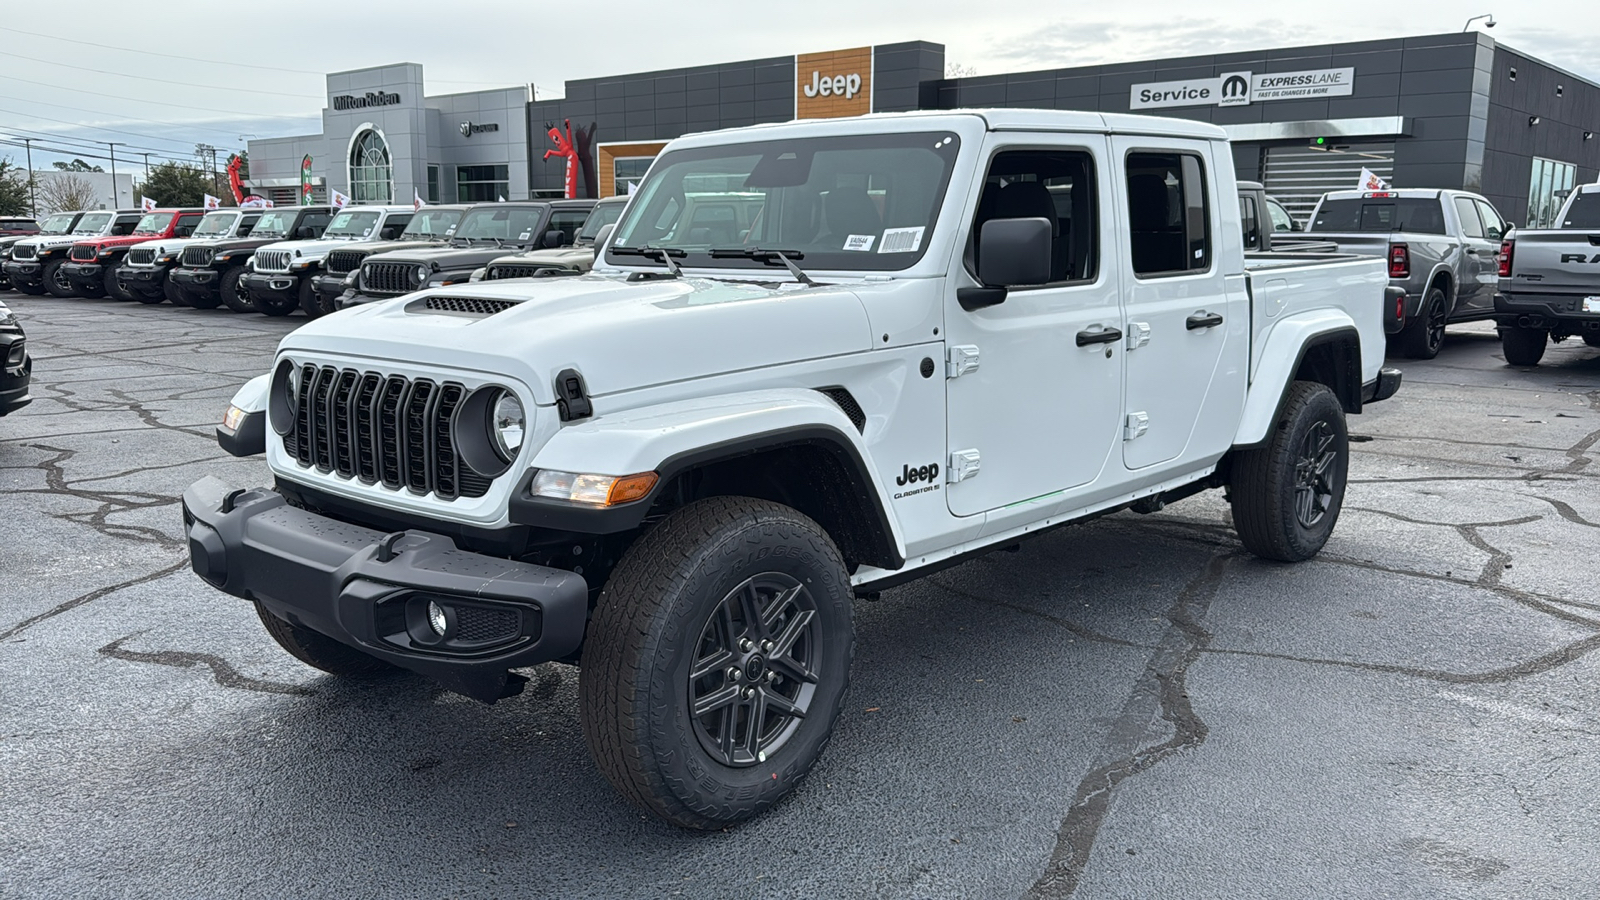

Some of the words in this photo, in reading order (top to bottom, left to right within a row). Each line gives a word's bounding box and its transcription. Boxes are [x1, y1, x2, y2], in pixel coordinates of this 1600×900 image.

[803, 71, 861, 98] Jeep
[1281, 89, 1306, 97] CHANGES
[333, 95, 366, 111] Milton
[366, 91, 401, 108] Ruben
[1140, 86, 1210, 103] Service
[896, 463, 939, 486] Jeep
[894, 486, 934, 499] GLADIATOR
